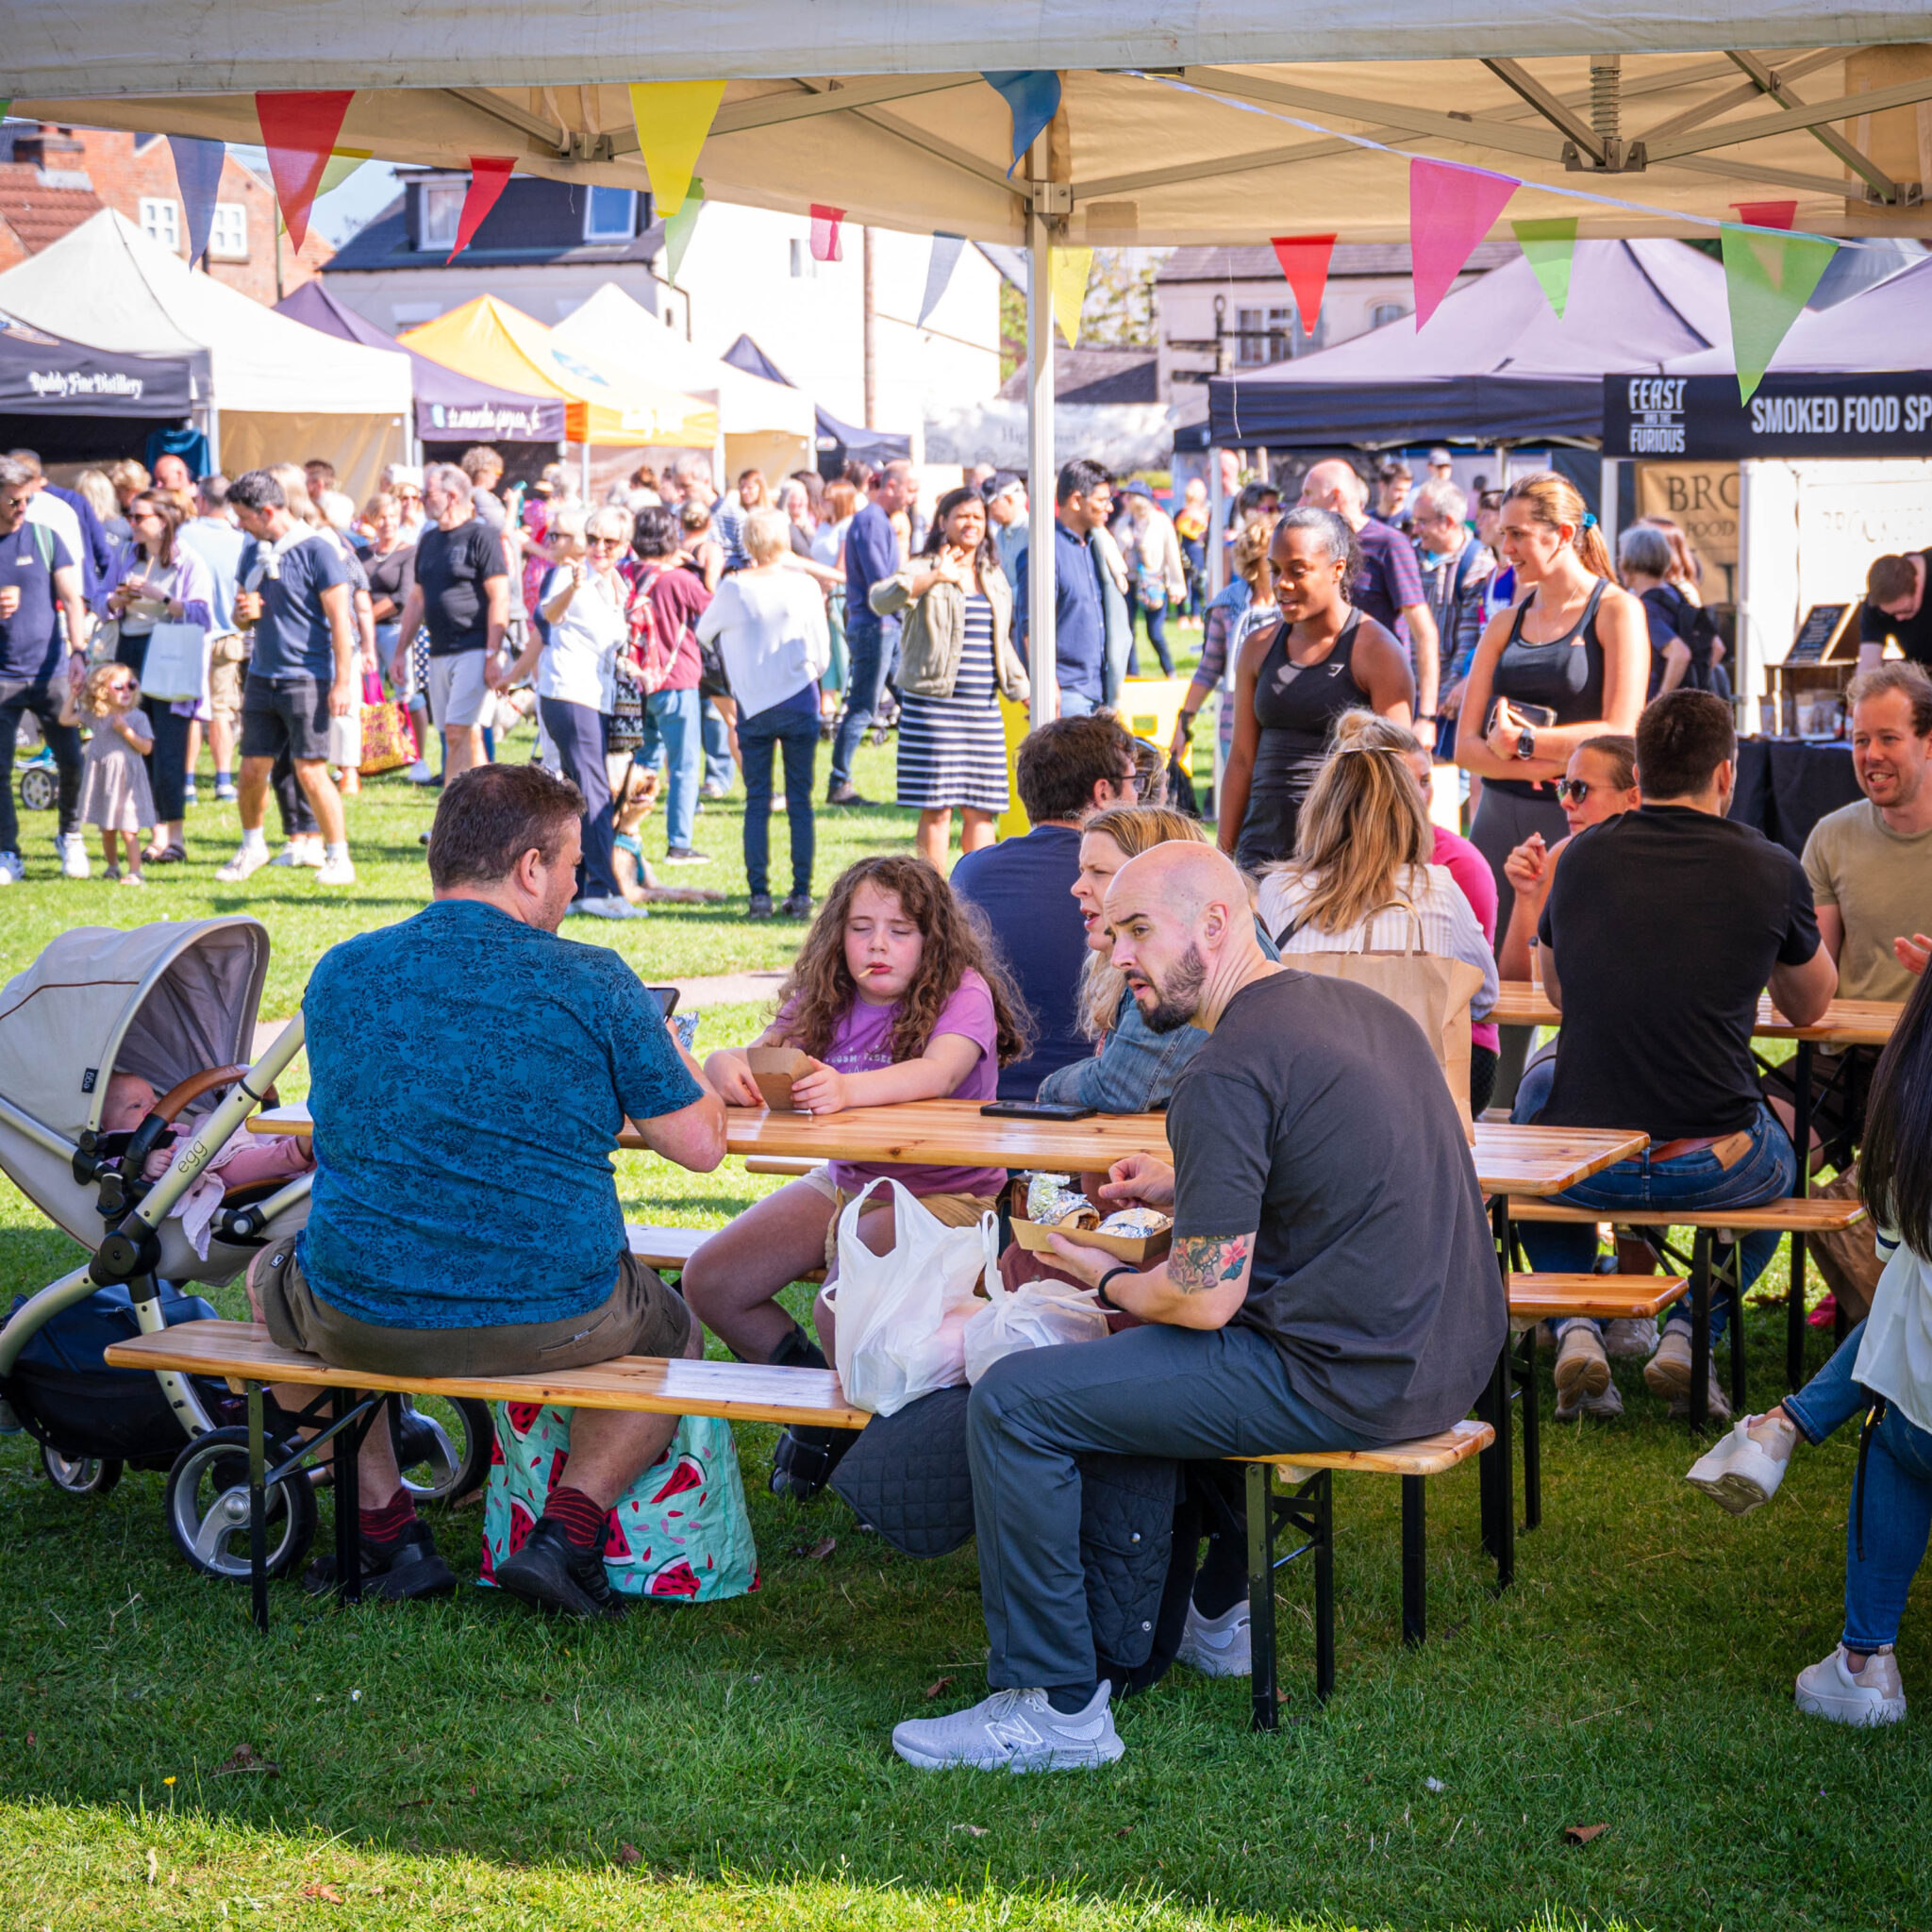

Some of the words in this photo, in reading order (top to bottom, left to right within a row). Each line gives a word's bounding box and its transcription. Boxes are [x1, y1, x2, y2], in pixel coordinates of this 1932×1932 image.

[29, 371, 68, 397] Ruddy
[68, 372, 93, 394] Fine
[93, 373, 142, 400] Distillery
[1628, 378, 1688, 409] FEAST
[1751, 396, 1840, 434] SMOKED
[1842, 395, 1900, 433] FOOD
[1629, 428, 1686, 453] FURIOUS
[83, 1072, 95, 1089] egg
[177, 1139, 208, 1174] egg
